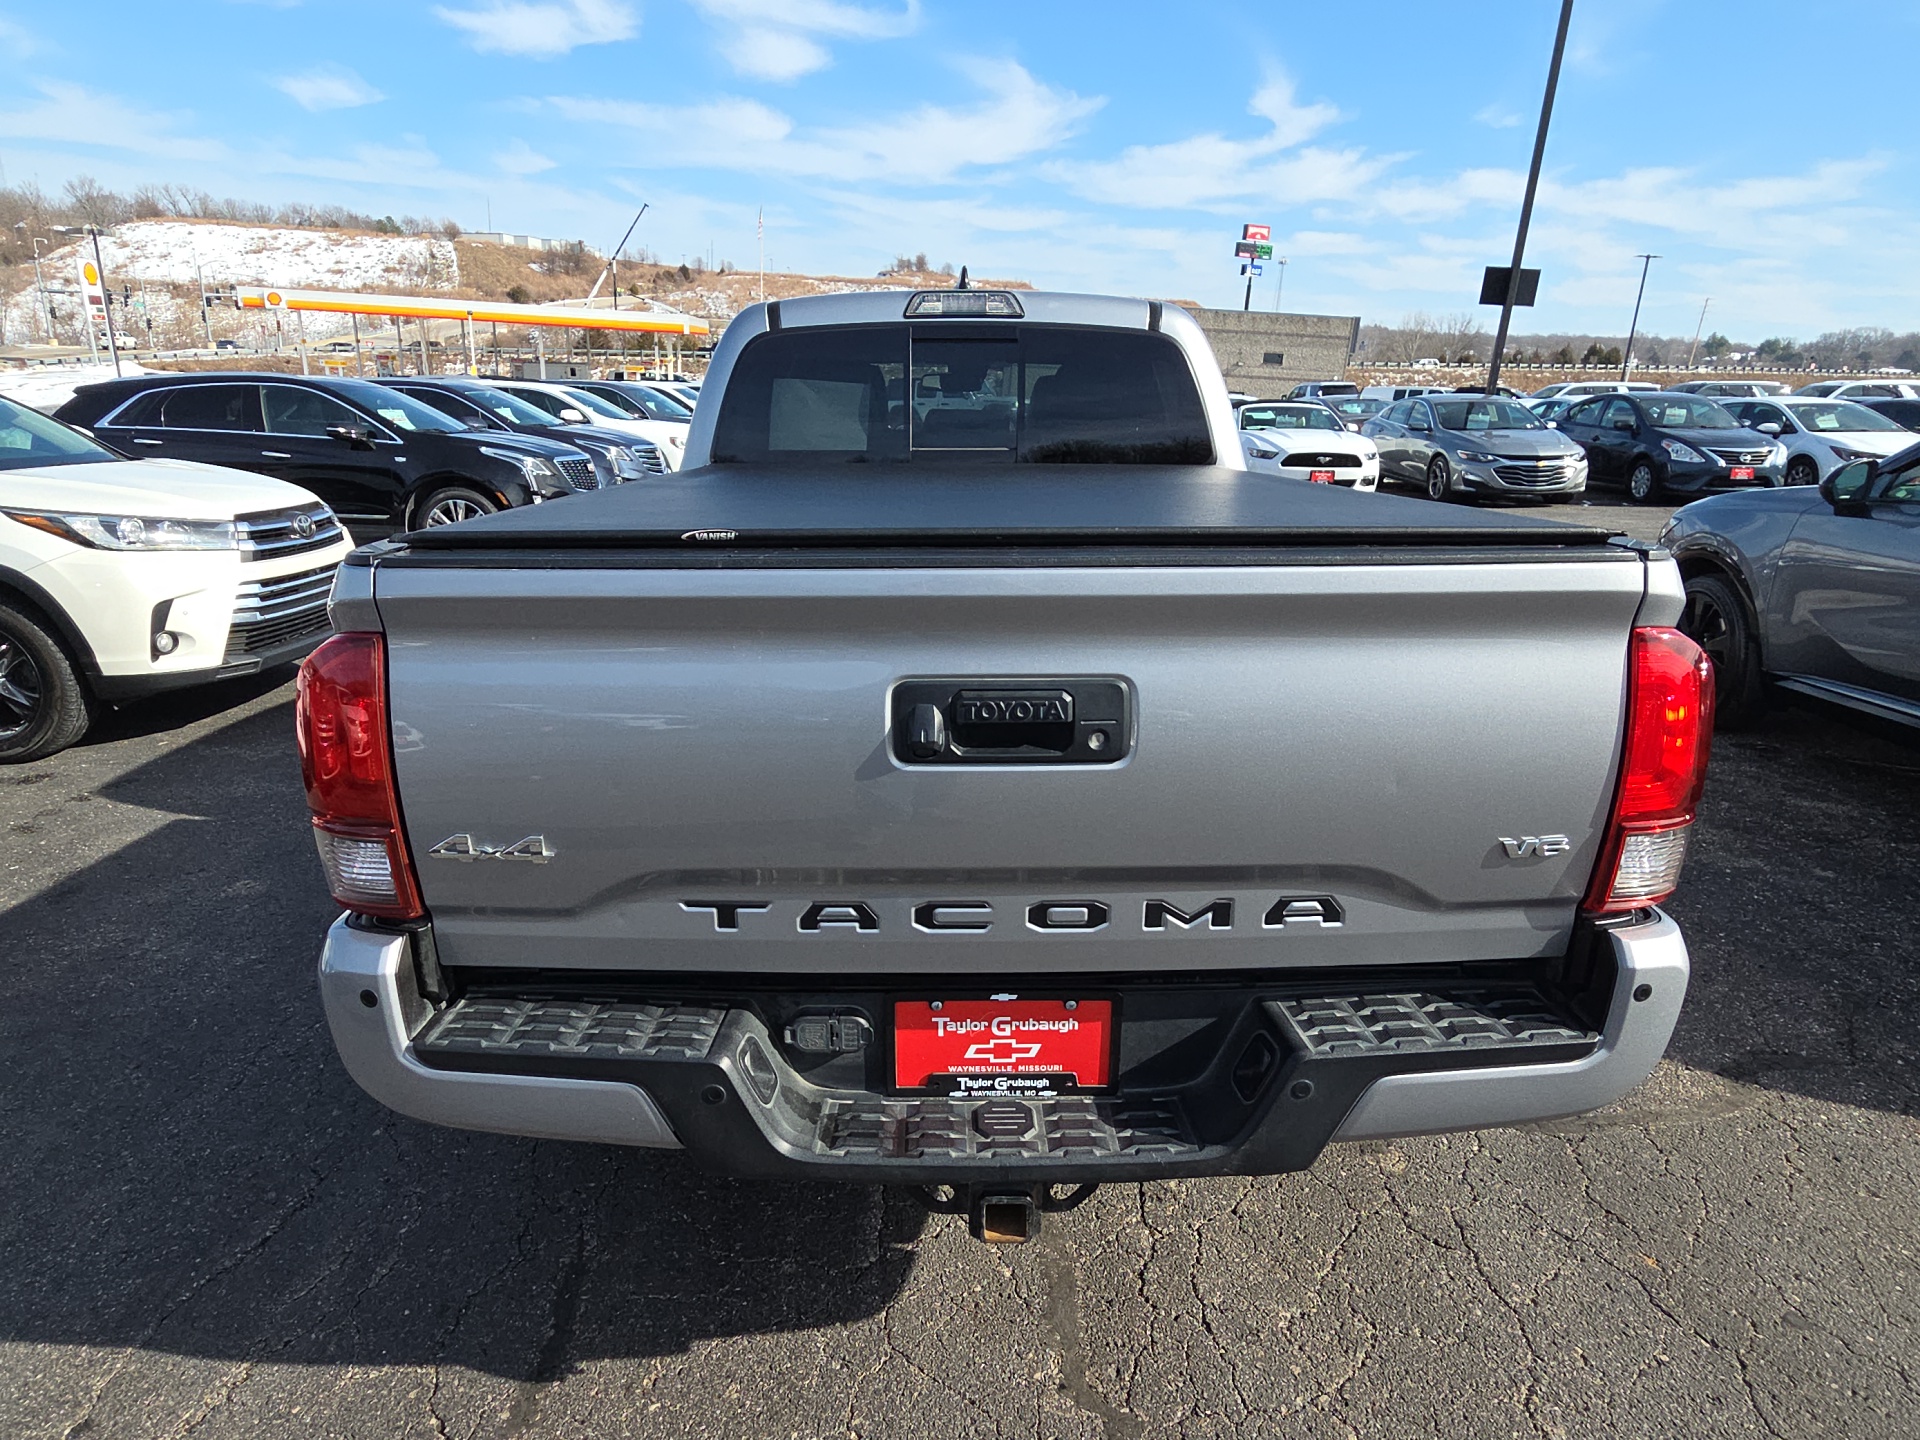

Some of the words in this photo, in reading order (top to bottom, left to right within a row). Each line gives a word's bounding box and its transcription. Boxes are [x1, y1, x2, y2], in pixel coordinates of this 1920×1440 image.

[695, 532, 736, 541] VANISH
[962, 700, 1065, 721] TOYOTA
[1498, 833, 1571, 859] V6
[678, 895, 1346, 934] TACOMA
[931, 1016, 989, 1037] Taylor
[991, 1016, 1079, 1037] Grubaugh
[947, 1065, 1016, 1073] WAYNESVILLE,
[1018, 1064, 1063, 1072] MISSOURI
[956, 1077, 993, 1090] Taylor
[994, 1077, 1050, 1090] Grubaugh
